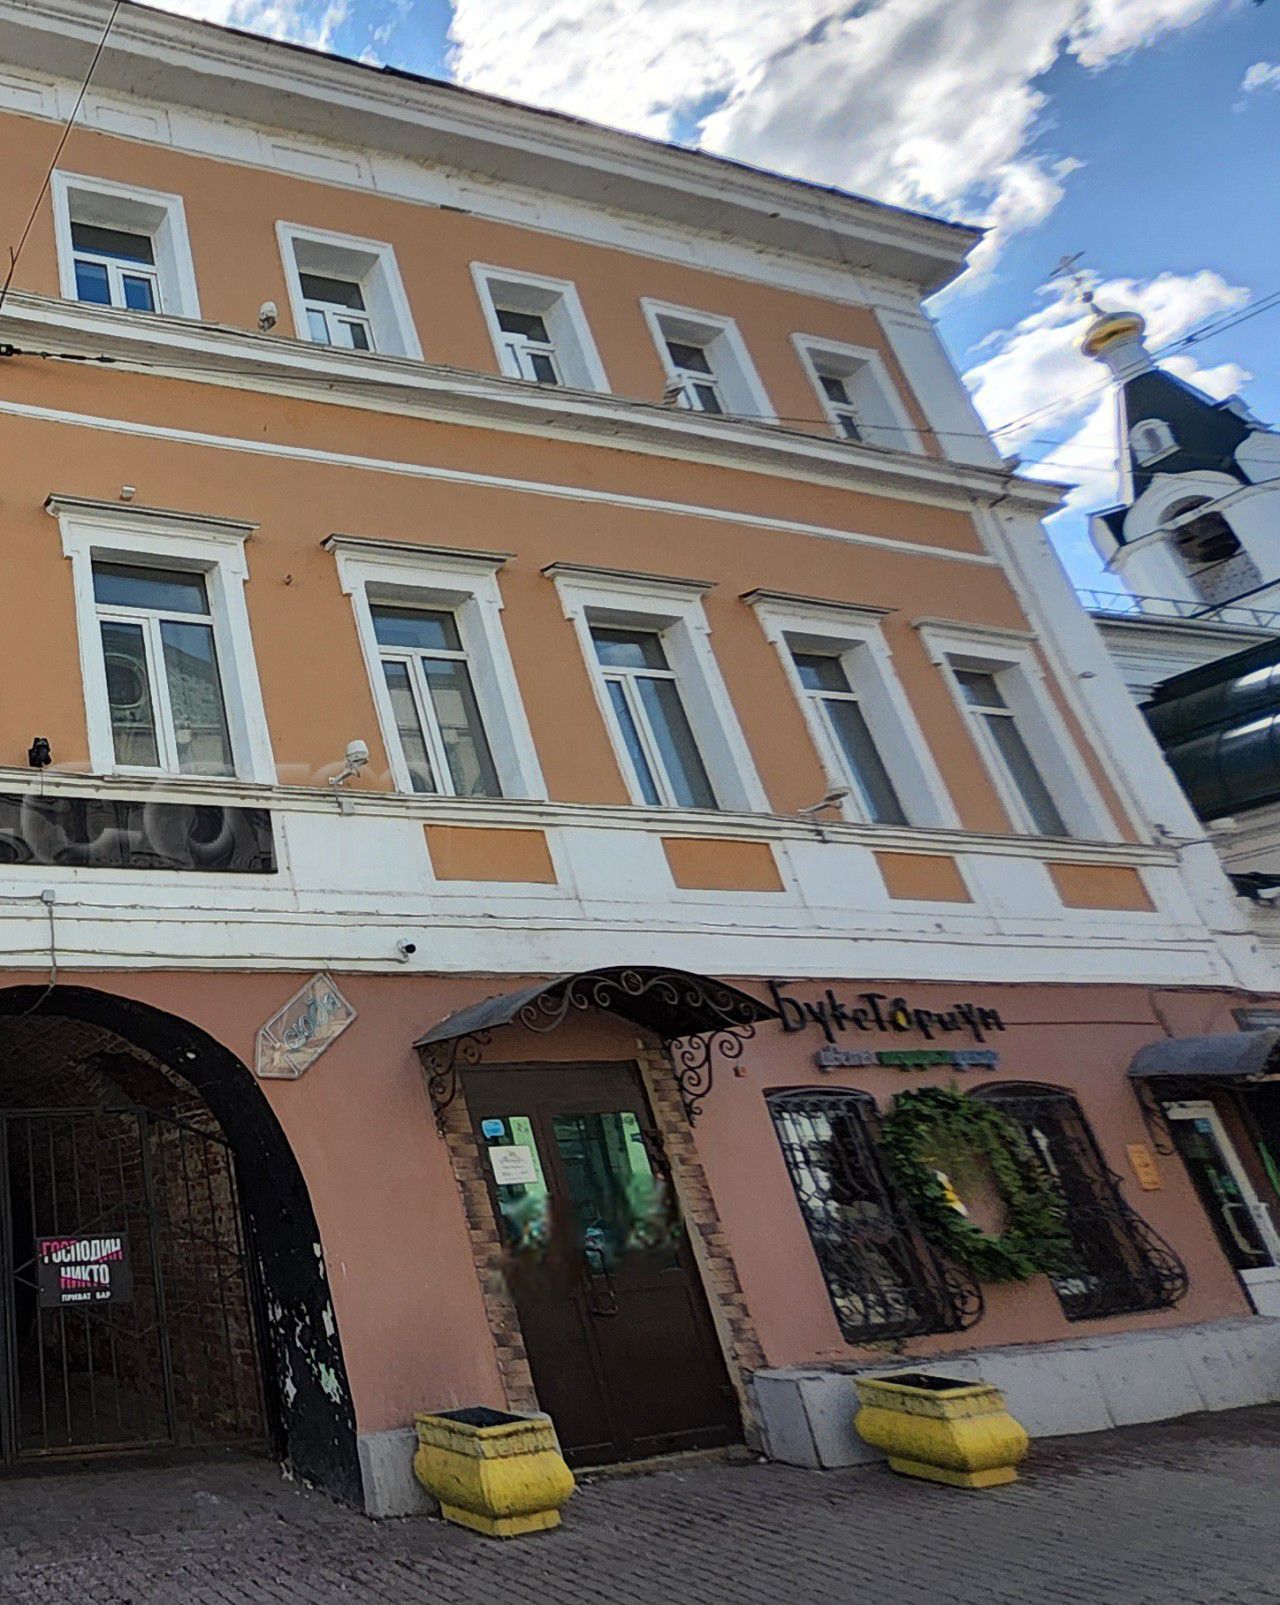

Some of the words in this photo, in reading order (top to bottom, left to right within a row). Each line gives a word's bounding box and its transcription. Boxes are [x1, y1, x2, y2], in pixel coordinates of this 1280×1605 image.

[41, 1237, 123, 1264] ГОСПОДИН
[59, 1263, 111, 1289] НИКТО
[61, 1292, 91, 1302] ПРИВАТ
[95, 1291, 111, 1300] БАР
